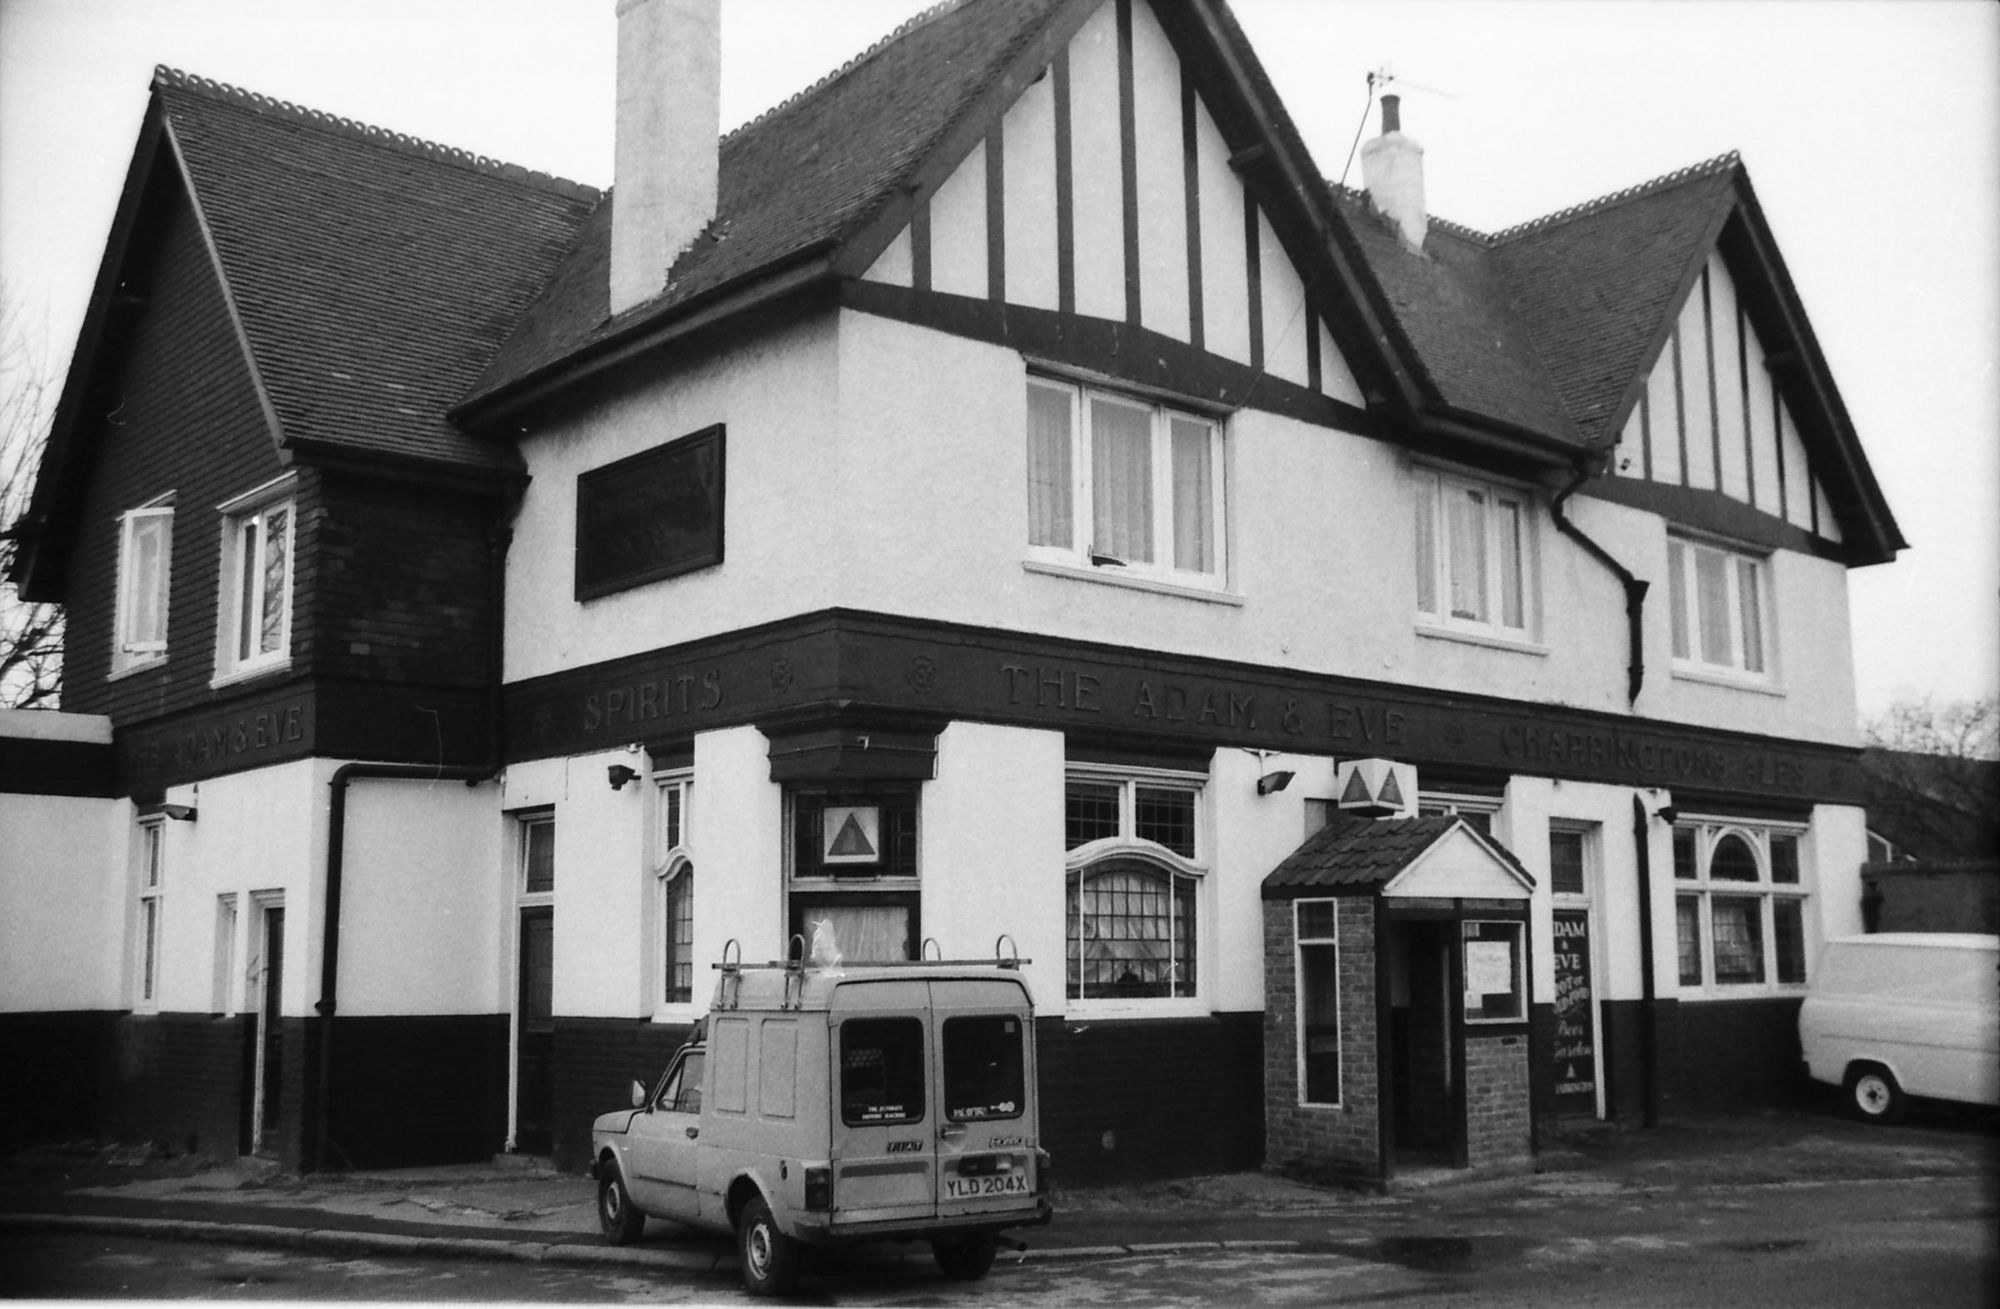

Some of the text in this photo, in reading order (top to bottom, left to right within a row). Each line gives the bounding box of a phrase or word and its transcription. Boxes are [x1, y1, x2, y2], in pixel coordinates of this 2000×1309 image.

[584, 668, 724, 732] SPIRITS
[1000, 664, 1405, 746] THE ADAM & EVE
[234, 718, 249, 754] &
[255, 704, 305, 750] EVE
[1553, 920, 1586, 938] DAM
[887, 1141, 923, 1154] FIAT
[946, 1175, 1027, 1196] YLD 204X
